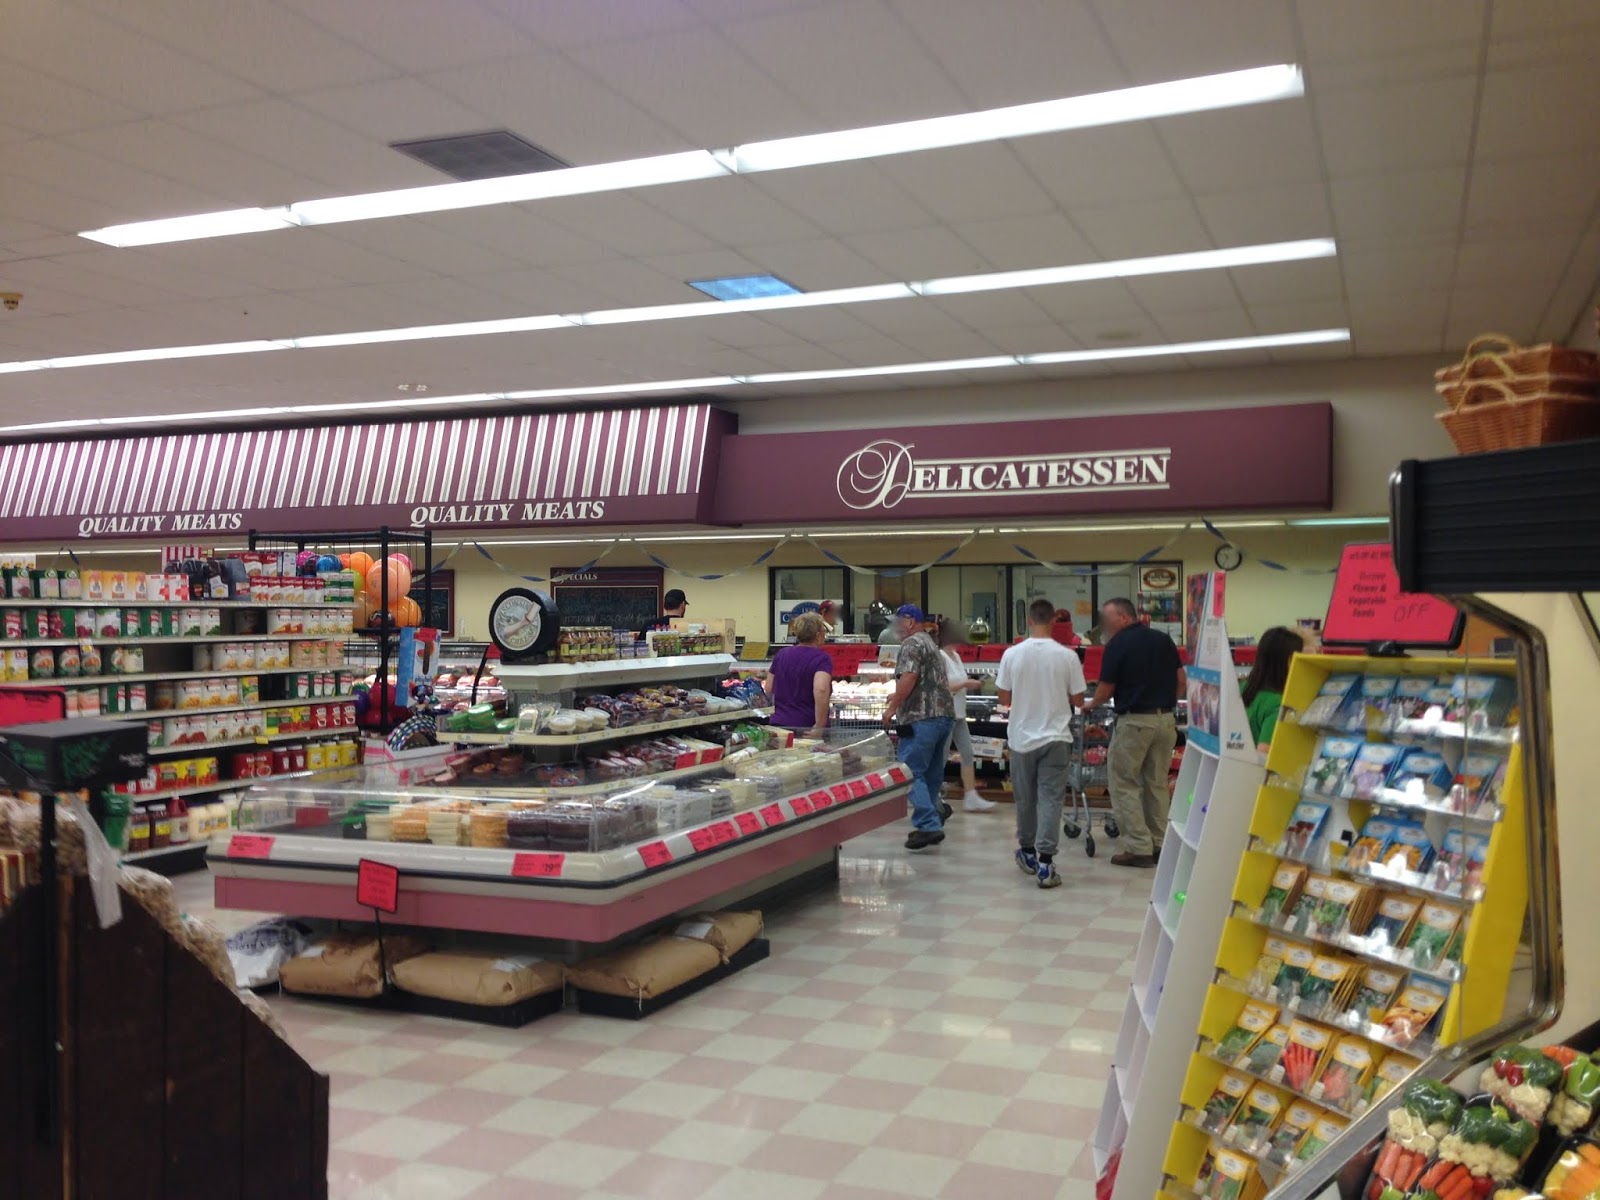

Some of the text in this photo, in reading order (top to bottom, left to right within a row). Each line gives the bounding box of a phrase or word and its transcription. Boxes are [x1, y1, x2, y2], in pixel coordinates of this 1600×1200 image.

[78, 512, 243, 538] QUALITY MEATS
[410, 501, 605, 528] QUALITY MEATS
